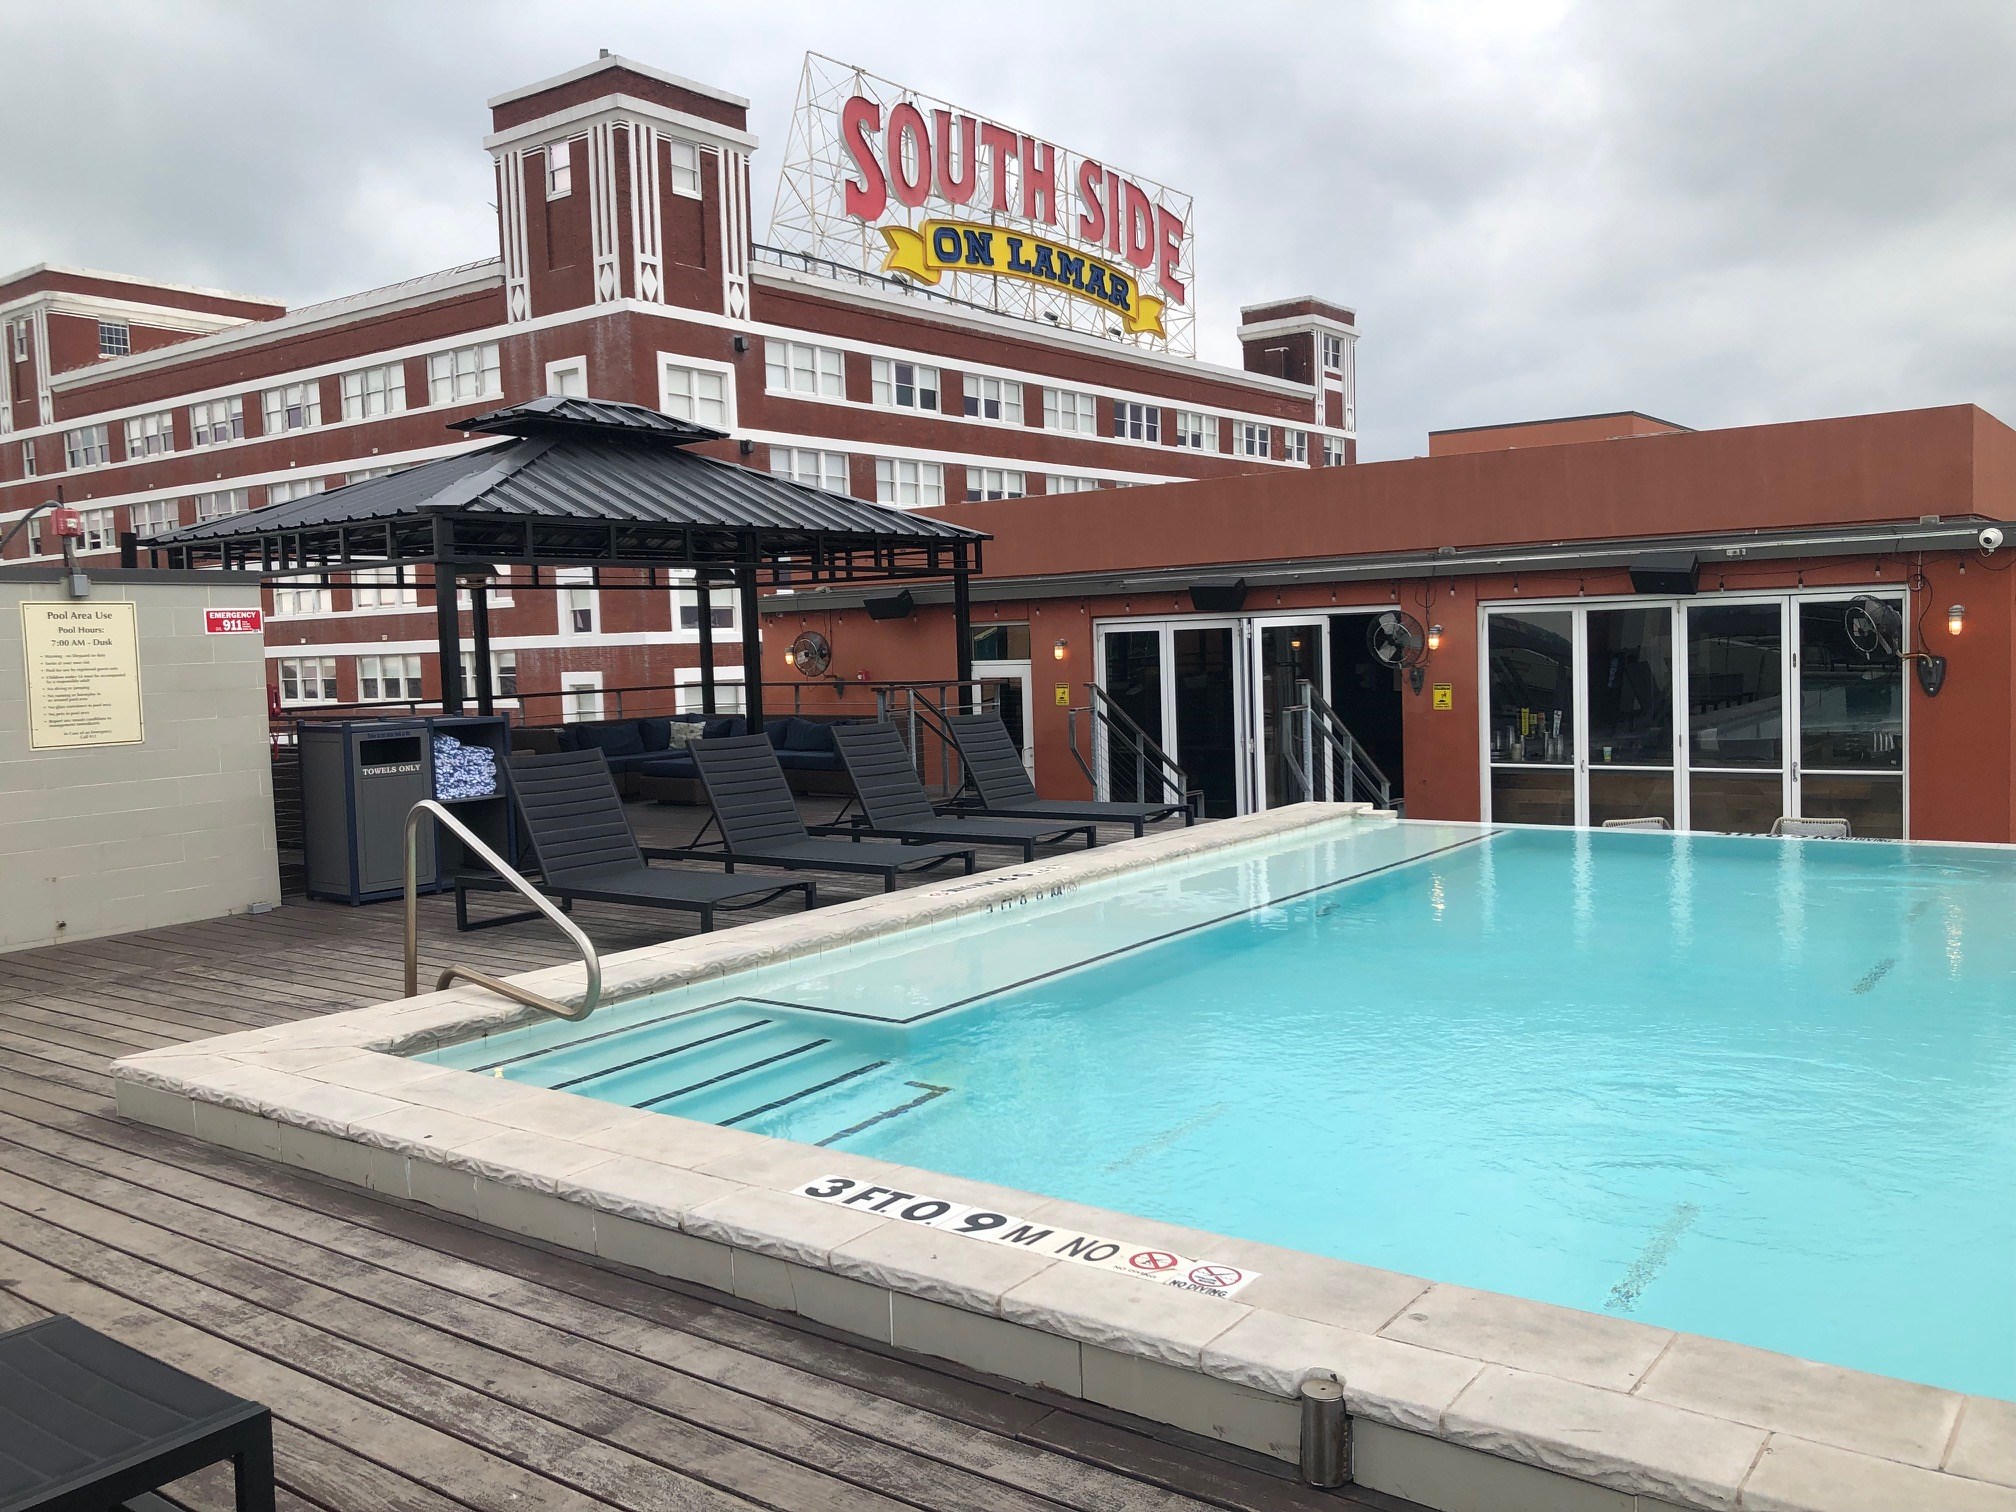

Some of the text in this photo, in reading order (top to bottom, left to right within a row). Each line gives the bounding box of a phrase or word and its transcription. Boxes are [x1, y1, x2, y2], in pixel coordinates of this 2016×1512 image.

[838, 96, 1185, 306] SOUTH SIDE
[933, 227, 1131, 311] ON LAMAR
[47, 611, 113, 620] Pool Area Use
[210, 611, 256, 619] EMERGENCY
[58, 626, 105, 634] Pool Hours:
[222, 619, 243, 631] 911
[51, 639, 70, 647] 7:00
[93, 638, 113, 646] Dusk
[362, 764, 420, 775] TOWELS ONLY
[804, 1178, 856, 1198] 3
[998, 1225, 1055, 1246] M
[1054, 1236, 1121, 1262] NO
[1168, 1279, 1229, 1298] NO DIVING
